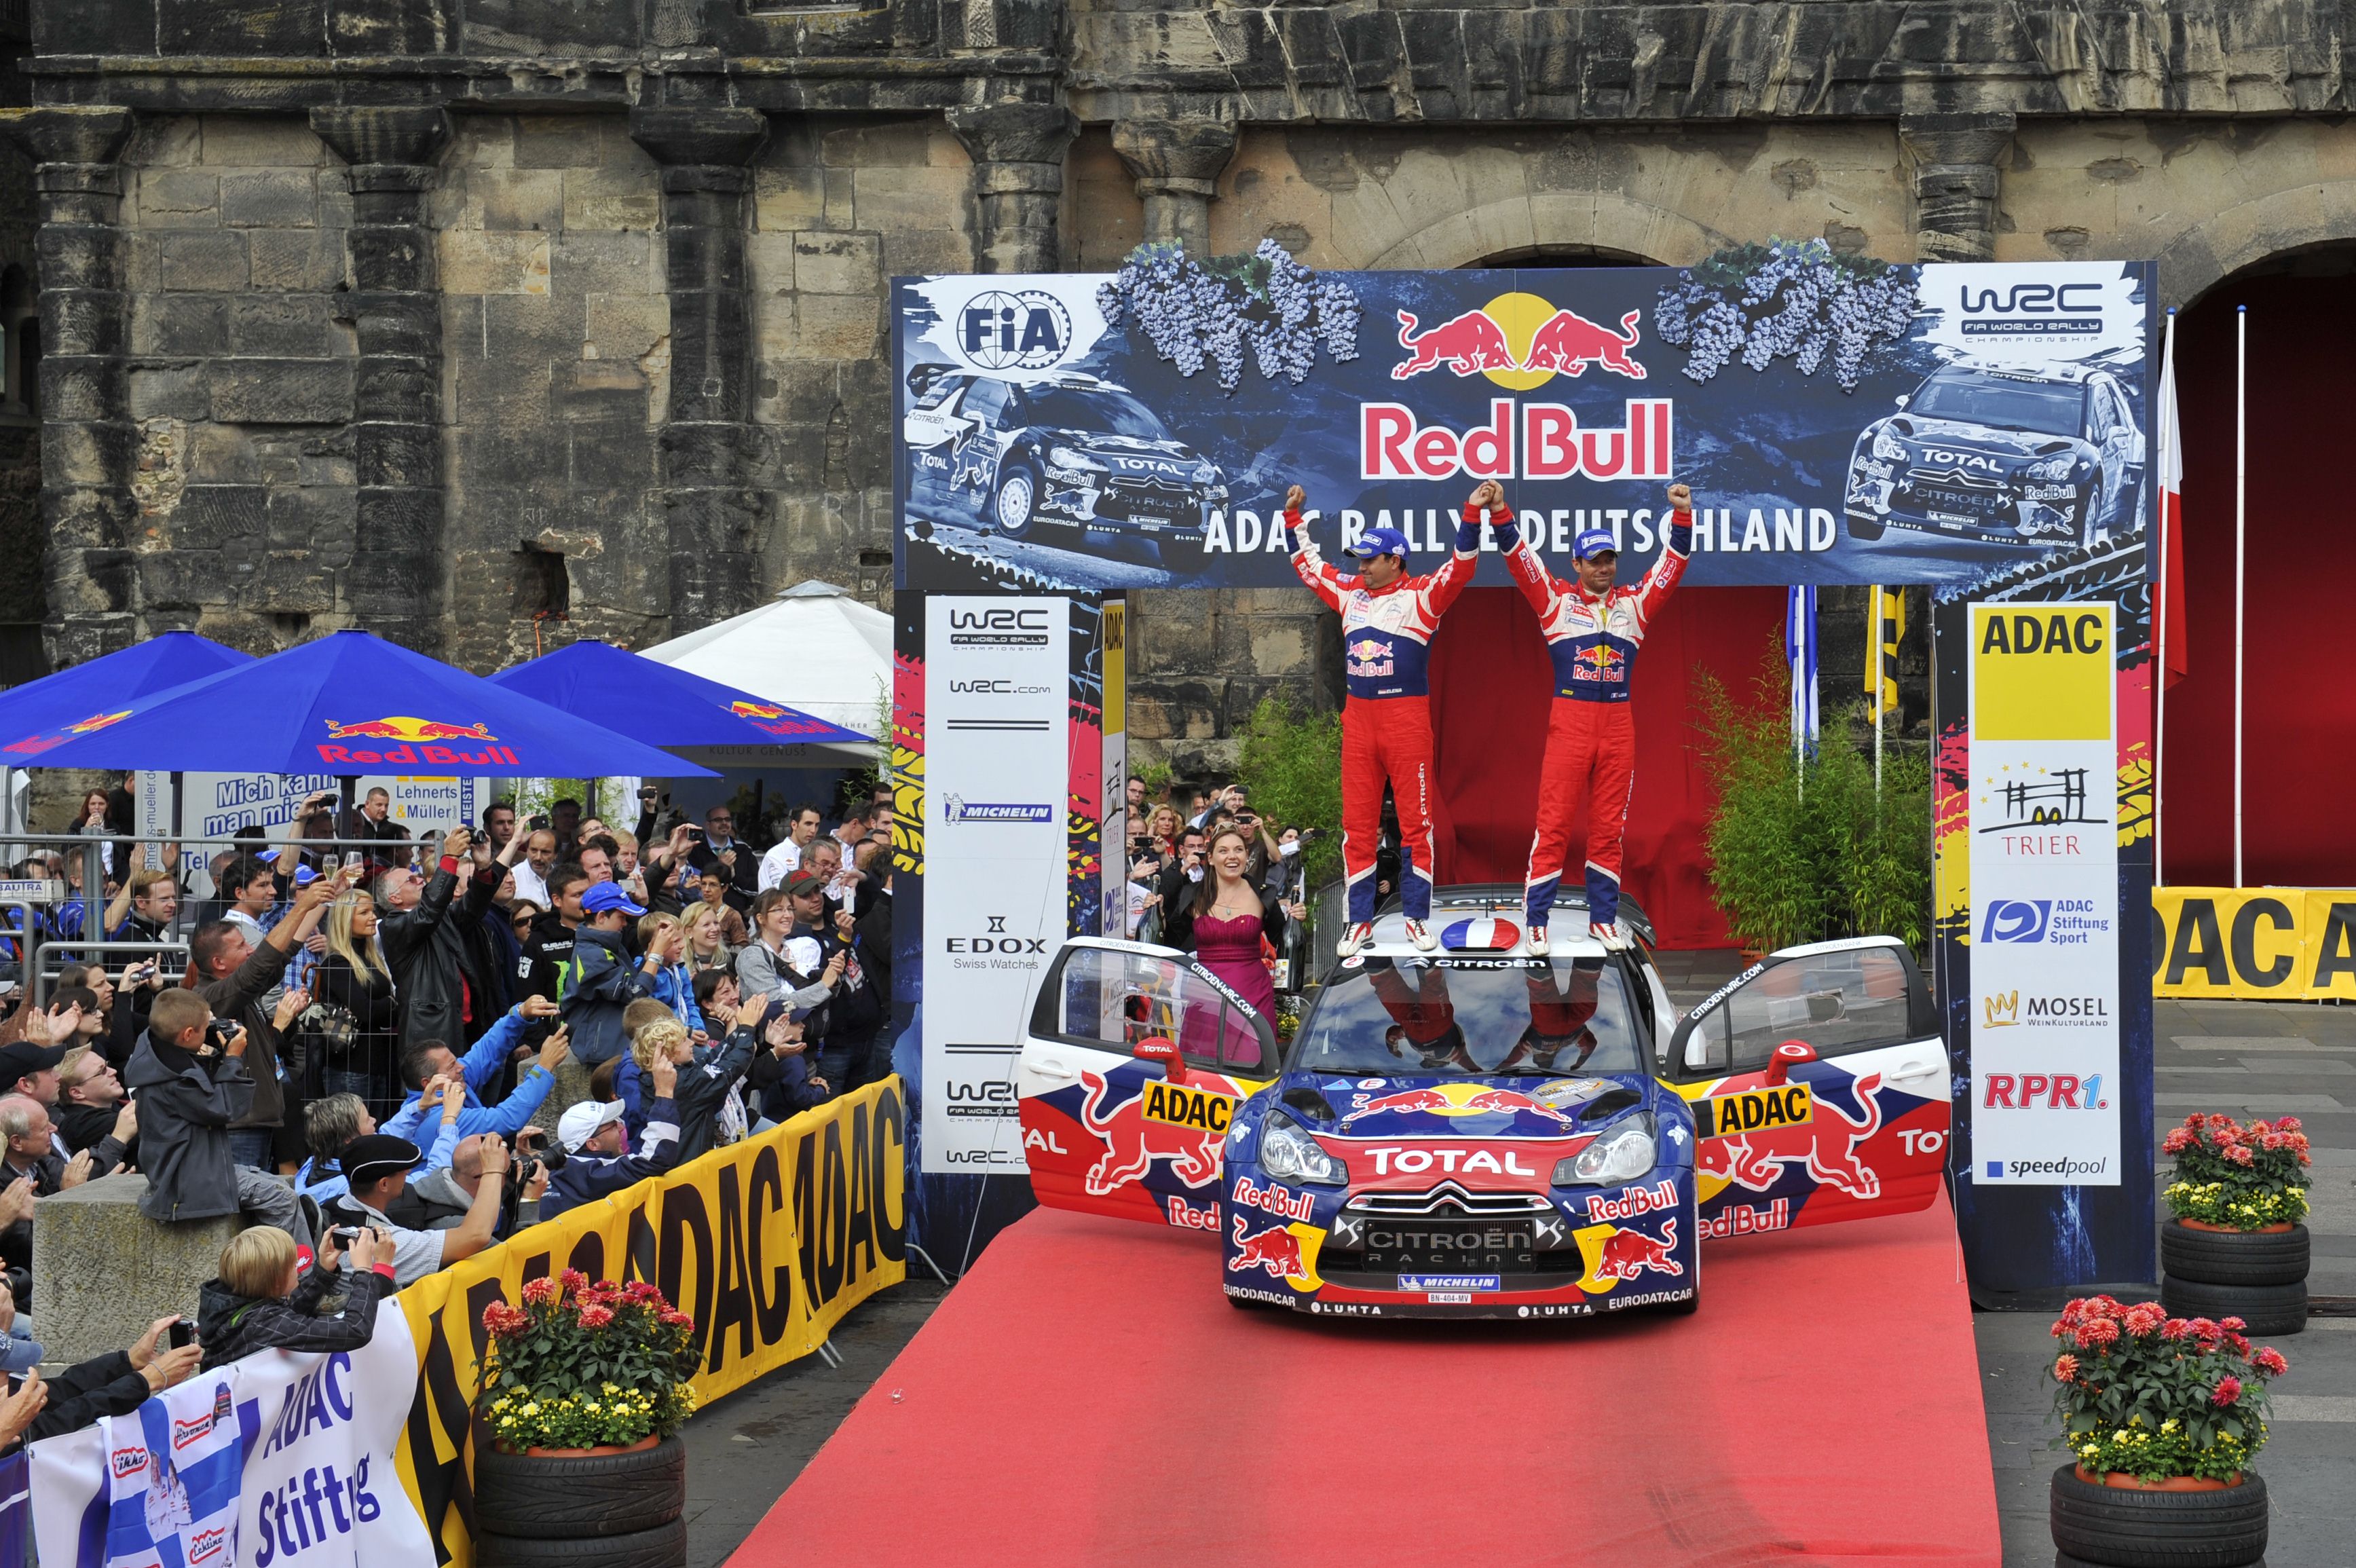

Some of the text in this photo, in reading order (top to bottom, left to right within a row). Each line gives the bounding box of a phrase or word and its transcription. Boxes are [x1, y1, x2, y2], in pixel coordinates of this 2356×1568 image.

[1961, 284, 2103, 312] WRC
[1965, 322, 2099, 332] FIA WORLD RALLY
[1990, 371, 2049, 384] CITROËN
[1364, 401, 1670, 478] Red Bull
[920, 451, 948, 470] TOTAL
[1112, 457, 1185, 476] TOTAL
[1854, 455, 1894, 480] Red Bull
[1920, 449, 2004, 474] TOTAL
[1045, 466, 1096, 487] Red Bull
[1915, 487, 1996, 508] CITROËN
[2025, 483, 2077, 500] Red Bull
[1032, 515, 1079, 528] EURODATACAR
[1093, 525, 1121, 534] LUHTA
[1893, 521, 1922, 531] LUHTA
[1939, 515, 1976, 524] MICHELIN
[1203, 509, 1321, 553] ADAC
[1989, 536, 2018, 544] LUHTA
[1525, 559, 1537, 582] TOTAL
[951, 610, 1048, 630] WRC
[1104, 610, 1123, 652] ADAC
[1981, 614, 2103, 654] ADAC
[1573, 665, 1624, 682] Red Bull
[316, 745, 521, 765] Red Bull
[709, 747, 807, 756] KULTUR GENUSS
[217, 774, 272, 808] Mich
[396, 785, 457, 799] Lehnerts
[462, 775, 472, 820] MEISTE
[1419, 762, 1427, 815] CITROËN
[965, 806, 1049, 818] MICHELIN
[204, 809, 256, 837] man
[2002, 835, 2081, 855] TRIER
[181, 851, 208, 870] Tel
[2056, 899, 2093, 913] ADAC
[2053, 916, 2109, 931] Stiftung
[946, 937, 1047, 954] EDOX
[2049, 932, 2088, 946] Sport
[954, 957, 1039, 969] Swiss Watches
[1434, 958, 1546, 968] CITROËN
[1191, 961, 1258, 1019] CITROEN-WRC.COM
[1690, 962, 1765, 1021] CITROEN-WRC.COM
[2027, 998, 2108, 1016] MOSEL
[1142, 1045, 1174, 1053] TOTAL
[948, 1080, 1018, 1101] WR
[1983, 1072, 2109, 1110] RPR1.
[1146, 1085, 1229, 1132] ADAC
[1719, 1087, 1808, 1134] ADAC
[1364, 1147, 1536, 1176] TOTAL
[2009, 1157, 2106, 1177] speedpool
[793, 1086, 907, 1322] ADAC
[1232, 1176, 1315, 1222] Red Bull
[1586, 1179, 1679, 1224] Red Bull
[1169, 1196, 1221, 1231] Red
[1699, 1197, 1789, 1239] ed Bull
[1368, 1228, 1531, 1249] CITROËN
[1368, 1253, 1531, 1263] RACING
[1423, 1278, 1495, 1287] MICHELIN
[1222, 1282, 1296, 1307] EURODATACAR
[1430, 1294, 1469, 1303] BN-404-MV
[1608, 1287, 1693, 1311] EURODATACAR
[1324, 1302, 1381, 1315] LUHTA
[1533, 1304, 1592, 1315] LUHTA
[263, 1351, 353, 1459] ADAC
[116, 1453, 145, 1471] ikko
[255, 1451, 381, 1568] Stiftg
